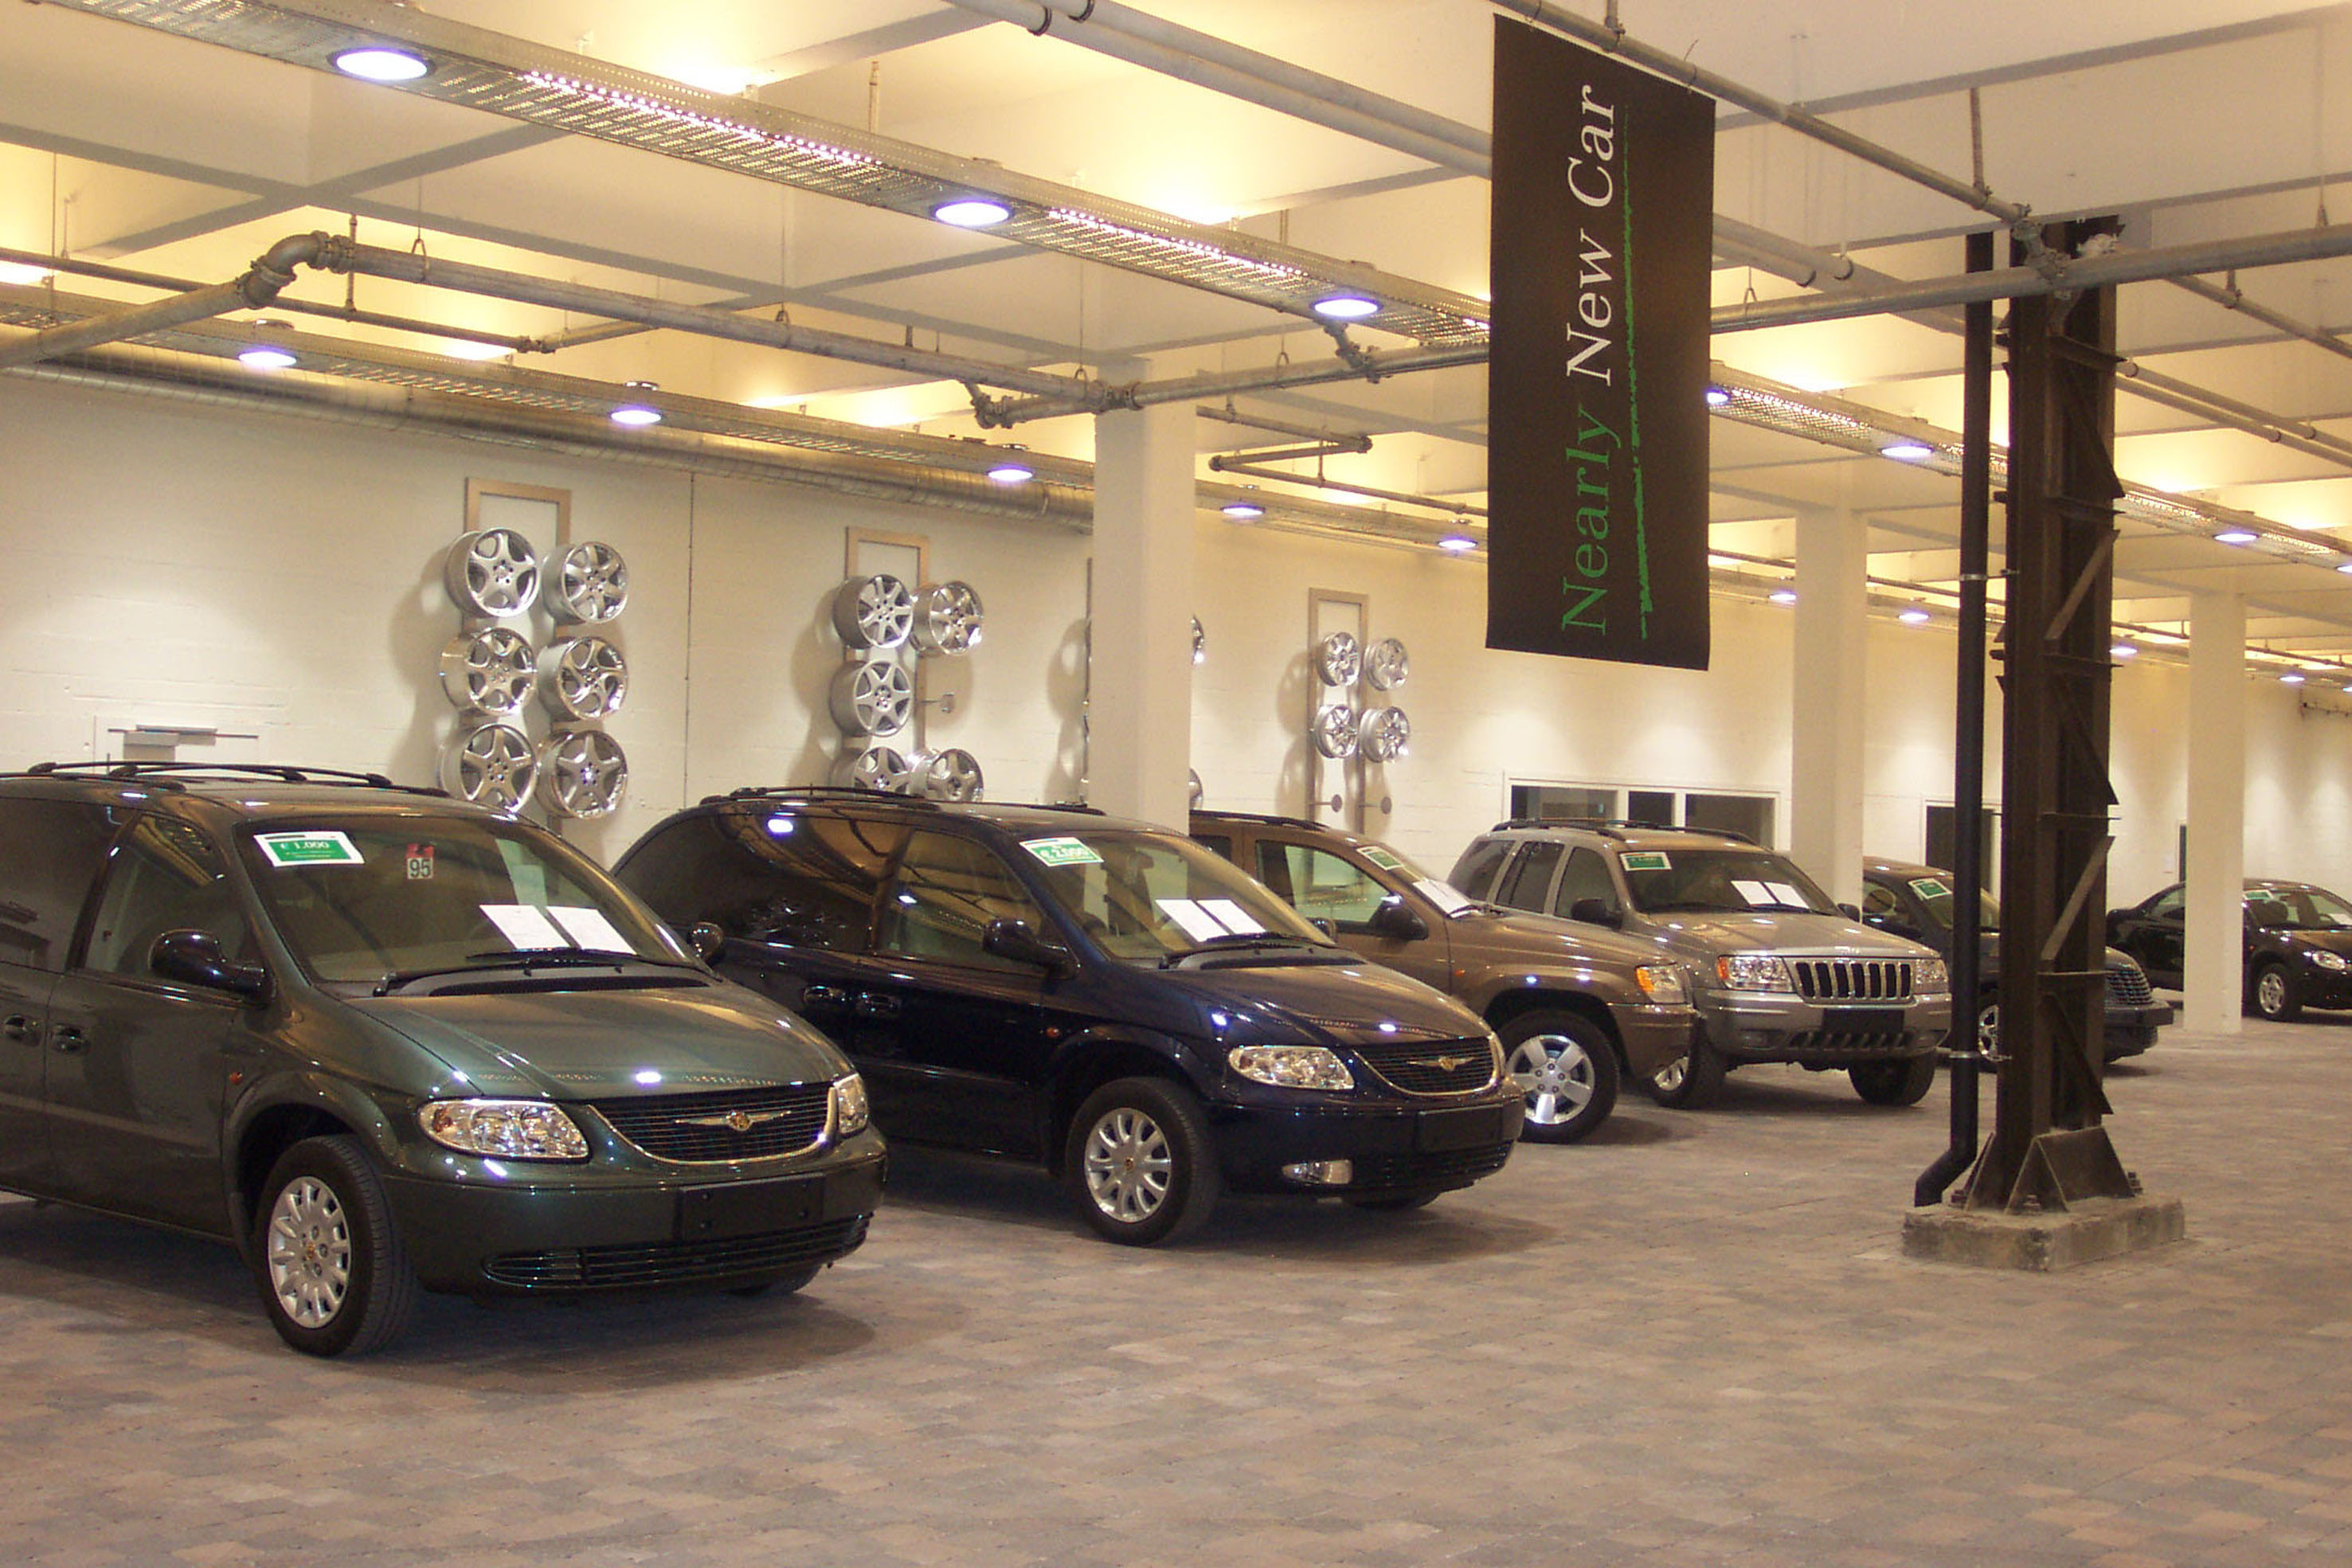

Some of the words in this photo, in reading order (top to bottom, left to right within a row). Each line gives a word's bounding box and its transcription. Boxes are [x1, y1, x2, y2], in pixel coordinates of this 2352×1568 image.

[1567, 85, 1615, 207] Car
[1567, 229, 1611, 386] New
[1562, 404, 1621, 635] Nearly
[409, 858, 431, 878] 95
